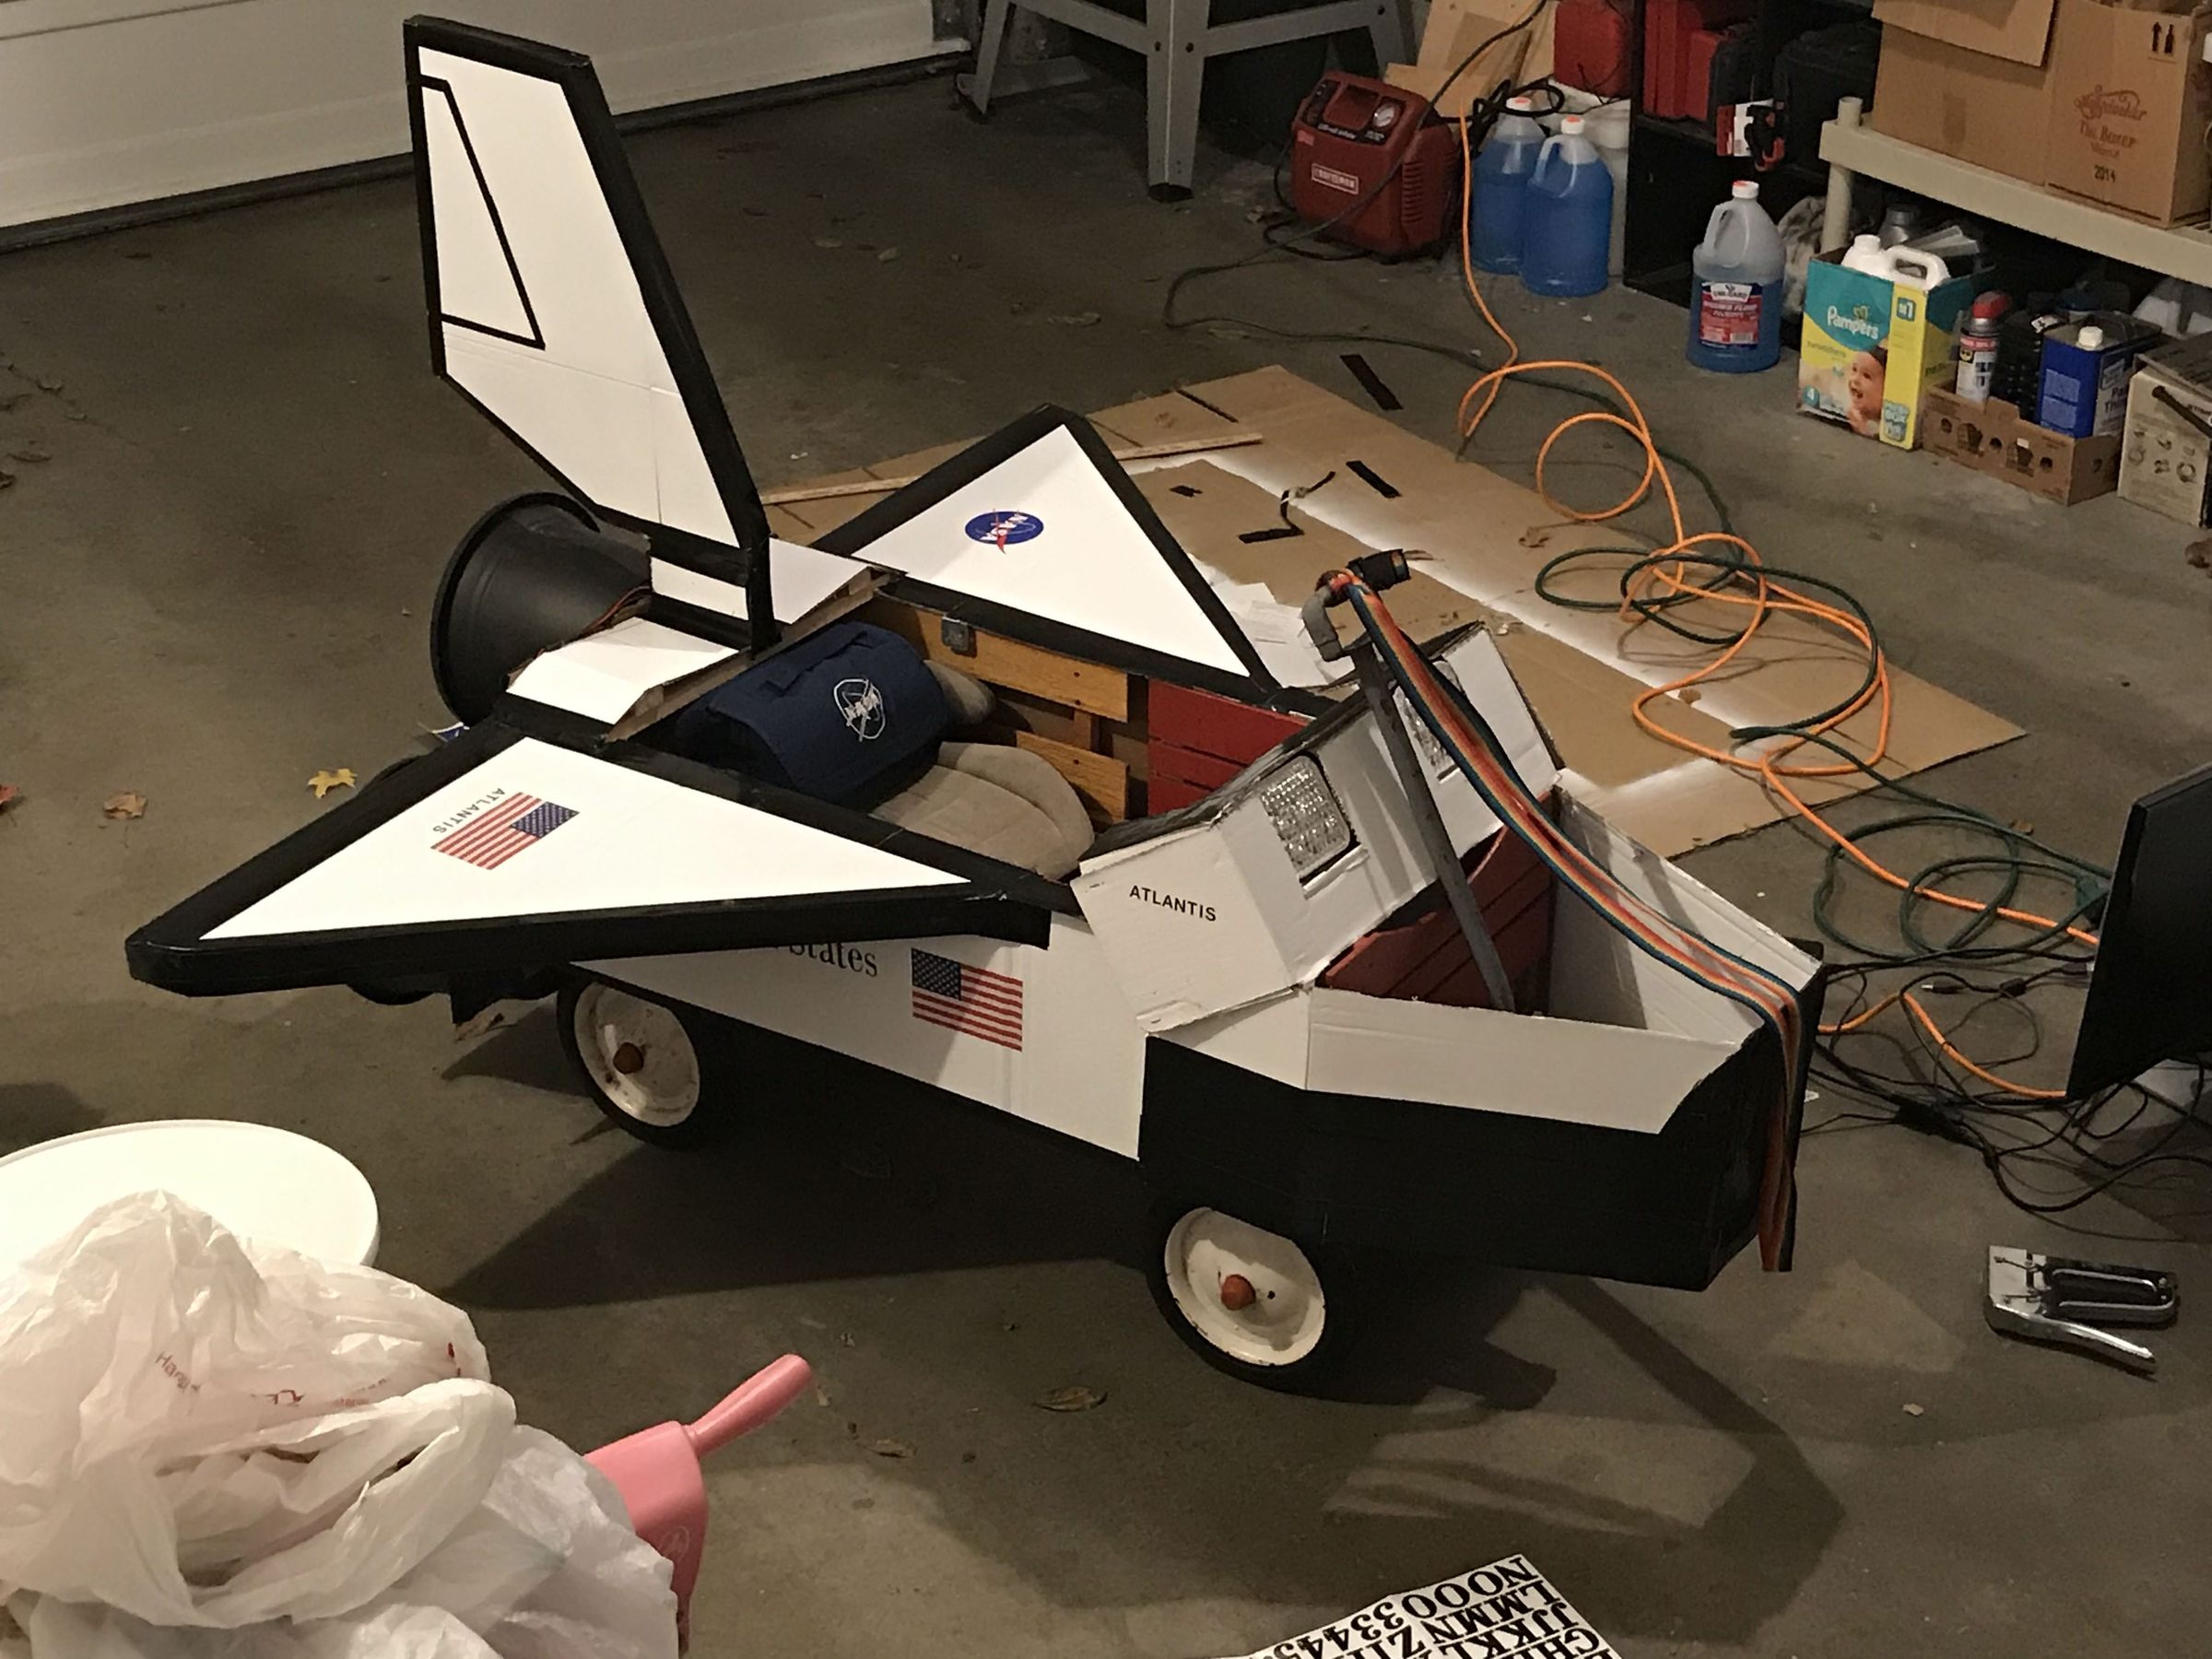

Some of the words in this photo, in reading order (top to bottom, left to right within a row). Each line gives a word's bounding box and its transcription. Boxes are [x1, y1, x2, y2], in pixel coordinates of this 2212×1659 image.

[1827, 305, 1879, 340] Pampers
[1806, 387, 1815, 401] 4
[432, 787, 506, 834] ATLANTIS
[1129, 885, 1217, 922] ATLANTIS
